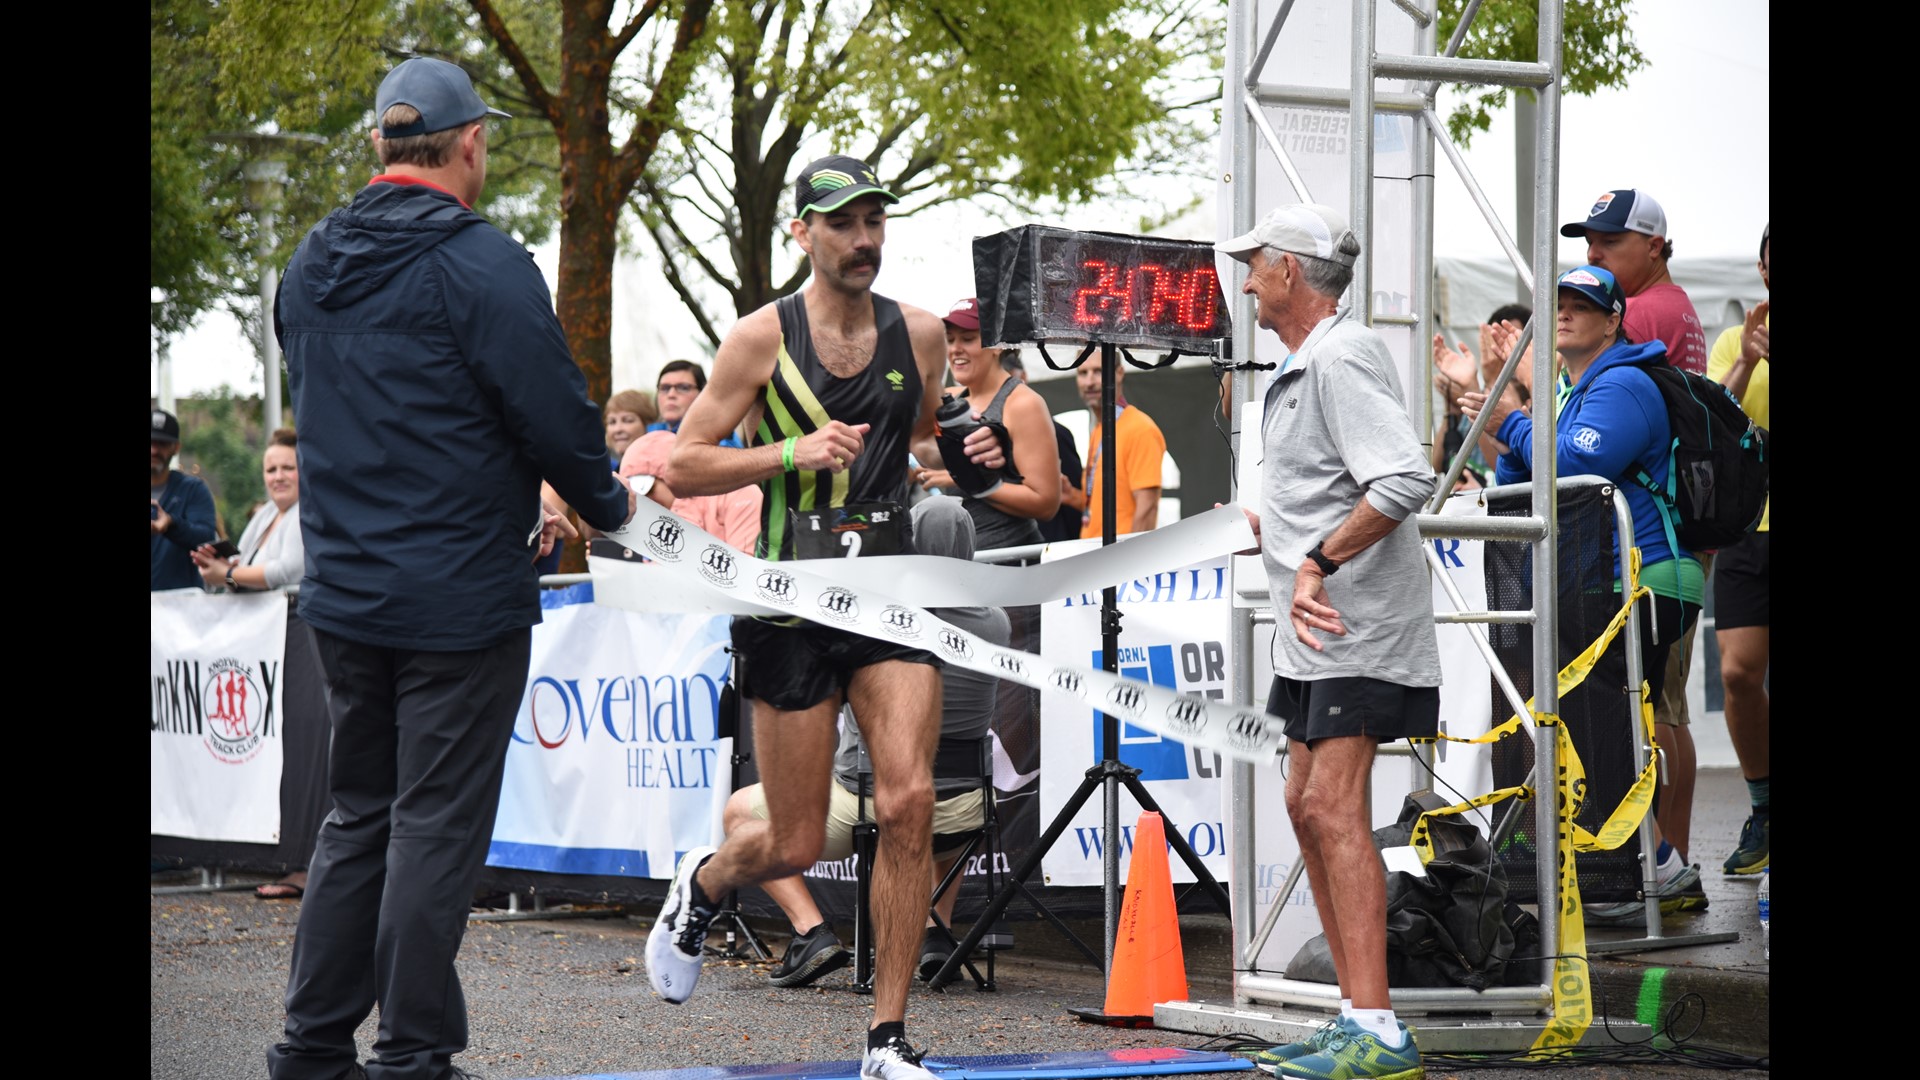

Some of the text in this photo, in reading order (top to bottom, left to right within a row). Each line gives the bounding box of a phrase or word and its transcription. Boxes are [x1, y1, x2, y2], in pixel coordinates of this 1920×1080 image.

[840, 530, 862, 559] 2
[208, 657, 253, 676] KNOXVILLE
[1118, 647, 1146, 662] ORNL
[511, 663, 732, 749] ovenan
[210, 733, 234, 755] TRACK
[235, 735, 260, 755] CLUB
[627, 748, 716, 788] HEALT
